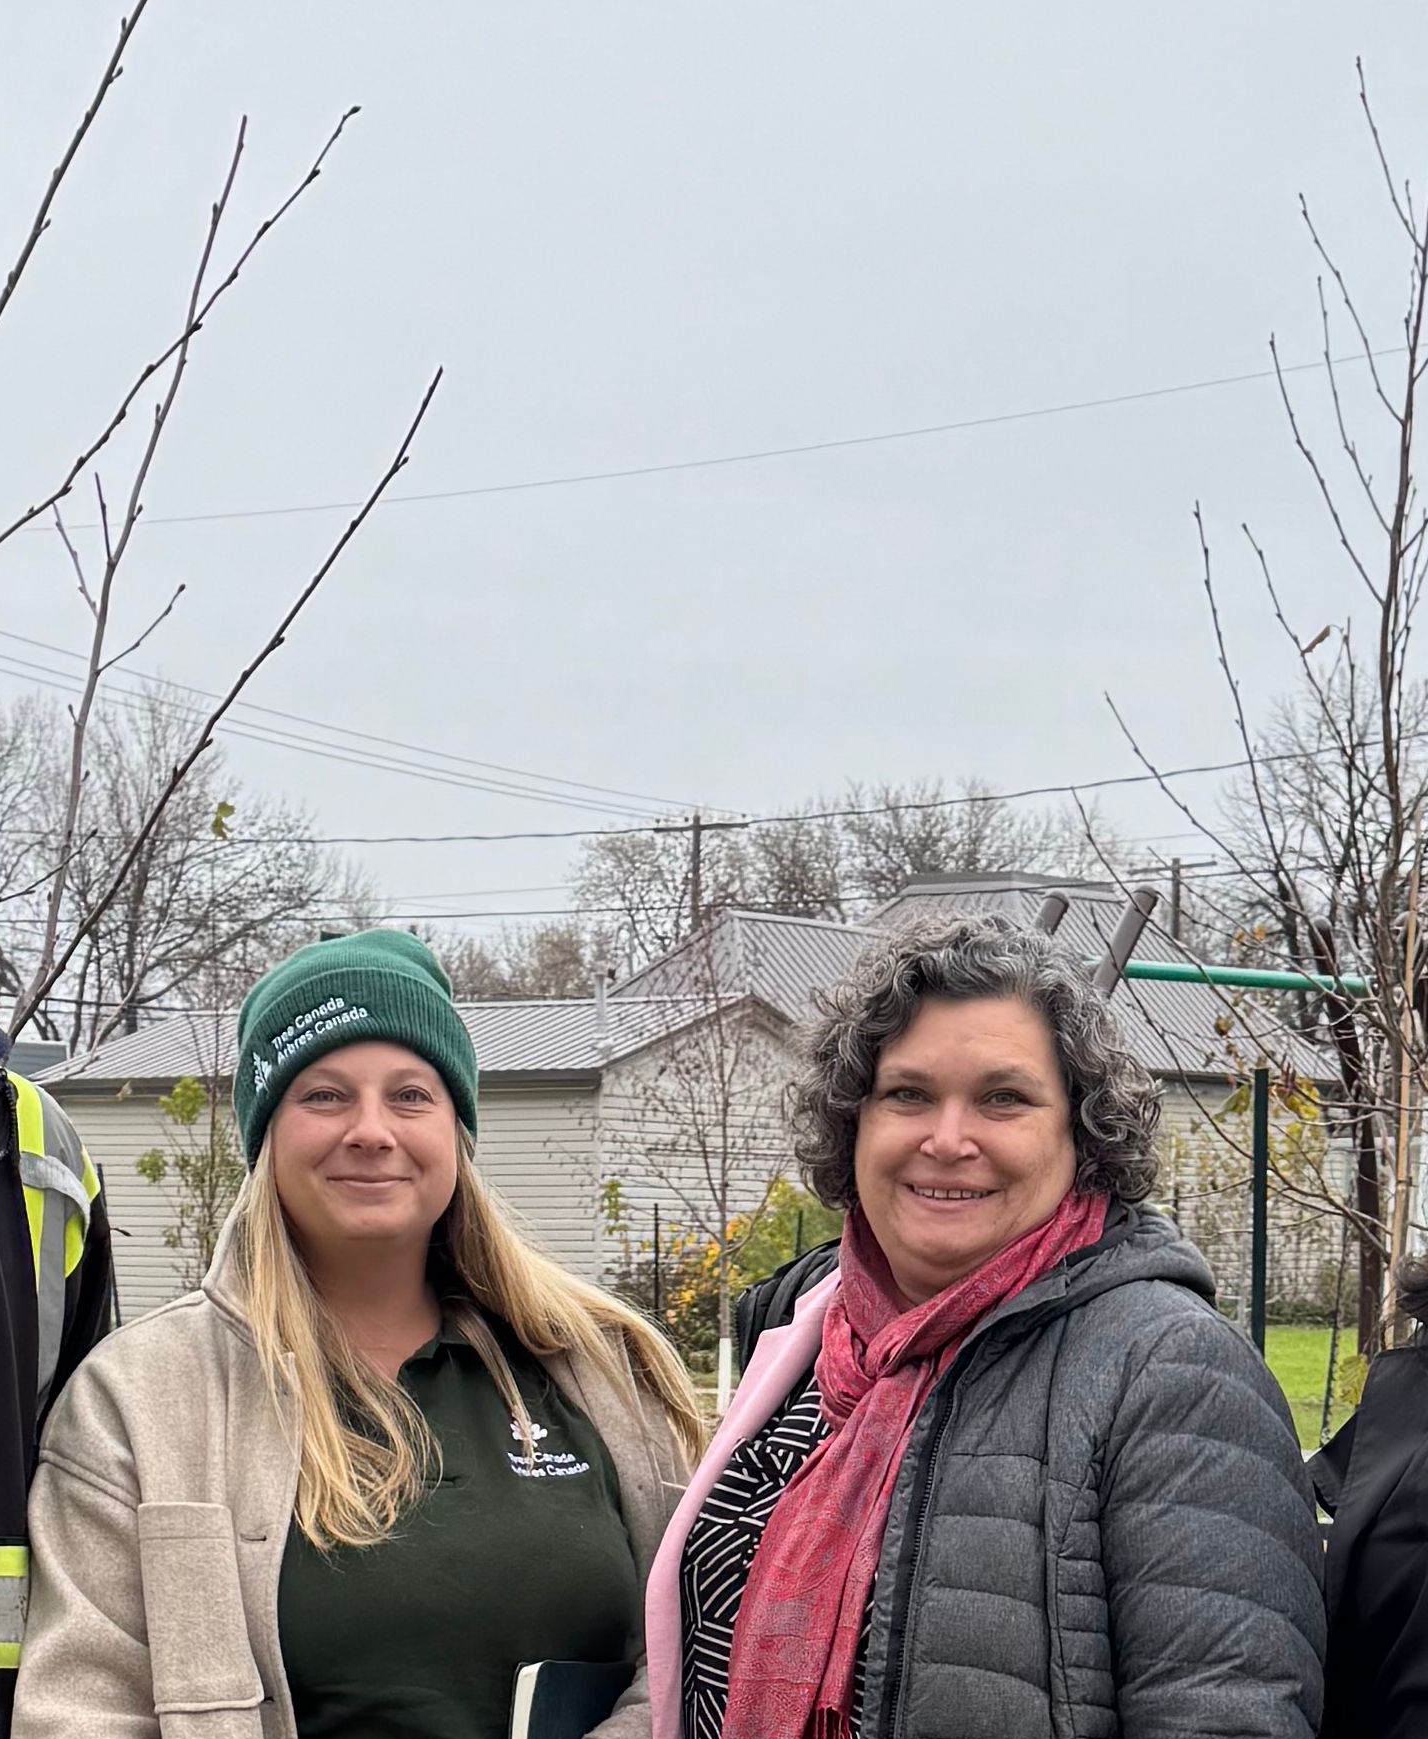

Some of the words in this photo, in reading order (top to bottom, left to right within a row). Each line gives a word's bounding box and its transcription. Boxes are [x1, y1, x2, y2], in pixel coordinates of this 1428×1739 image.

[272, 1026, 294, 1050] Tree
[295, 997, 345, 1029] Canada
[277, 1030, 313, 1065] Arbres
[314, 1006, 368, 1034] Canada
